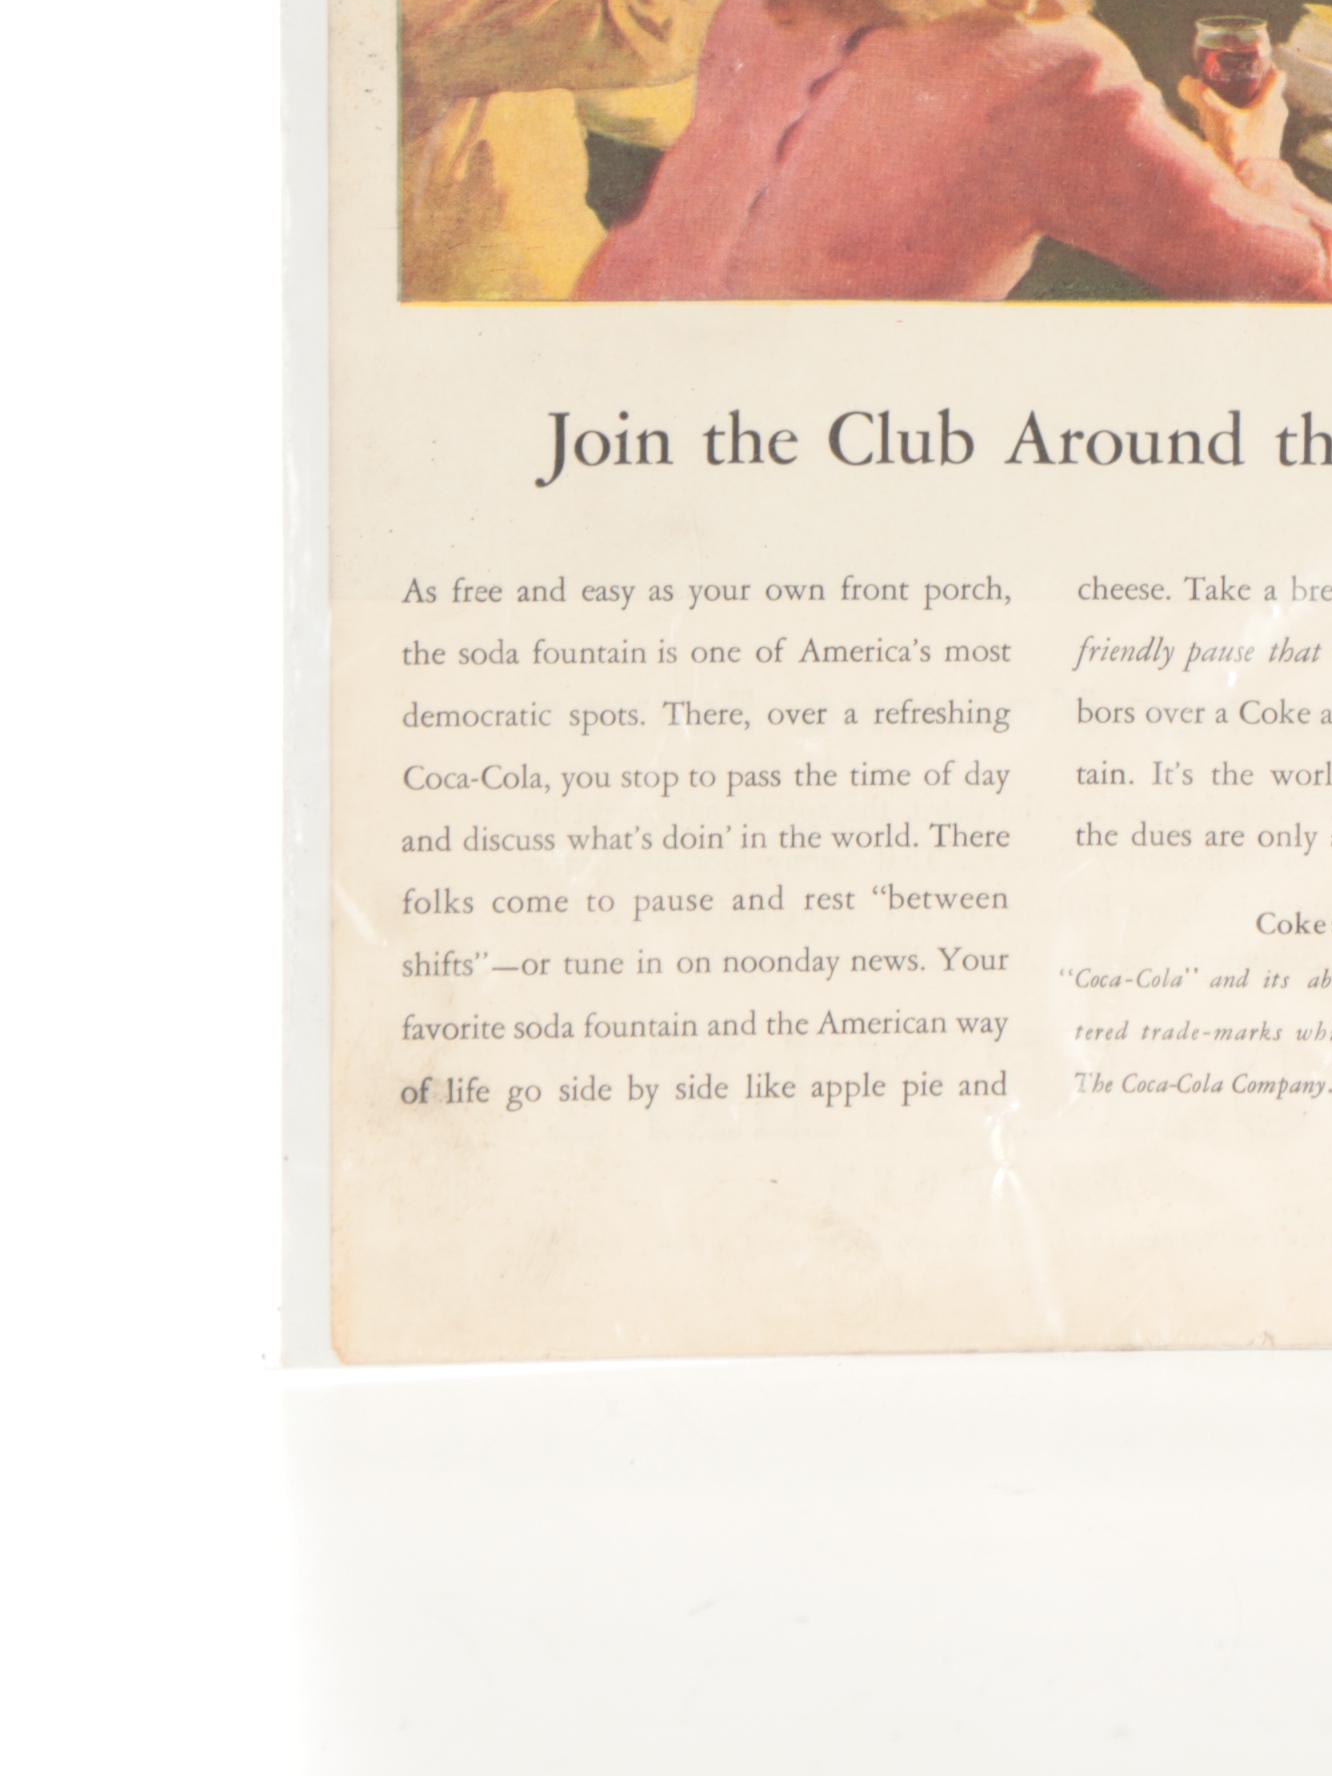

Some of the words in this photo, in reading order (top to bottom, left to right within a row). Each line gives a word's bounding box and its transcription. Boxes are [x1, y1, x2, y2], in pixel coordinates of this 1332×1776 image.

[533, 409, 674, 489] Join
[702, 408, 799, 467] the
[827, 406, 976, 467] Club
[1003, 408, 1246, 467] Around
[401, 577, 438, 604] As
[452, 576, 504, 604] free
[516, 575, 567, 603] and
[581, 584, 636, 612] easy
[648, 583, 675, 603] as
[688, 583, 752, 611] your
[764, 583, 826, 602] own
[840, 573, 910, 602] front
[923, 574, 1012, 612] porch,
[1077, 574, 1172, 601] cheese.
[1183, 574, 1252, 602] Take
[1263, 584, 1278, 602] a
[401, 639, 447, 667] the
[458, 637, 520, 666] soda
[532, 637, 647, 665] fountain
[657, 638, 678, 664] is
[690, 645, 742, 664] one
[754, 636, 788, 664] of
[798, 637, 932, 664] America's
[944, 643, 1012, 663] most
[1071, 634, 1176, 672] friendly
[1182, 641, 1255, 673] pause
[1268, 635, 1322, 664] that
[401, 700, 552, 729] democratic
[569, 707, 646, 737] spots.
[661, 699, 751, 731] There,
[766, 707, 828, 726] over
[843, 707, 859, 726] a
[873, 697, 1012, 734] refreshing
[1076, 696, 1136, 725] bors
[1144, 706, 1206, 725] over
[1214, 707, 1229, 725] a
[1238, 697, 1312, 726] Coke
[402, 762, 551, 794] Coca-Cola,
[561, 771, 611, 798] you
[620, 769, 680, 799] stop
[688, 768, 717, 788] to
[726, 769, 782, 798] pass
[793, 761, 838, 788] the
[849, 761, 912, 787] time
[923, 759, 956, 786] of
[963, 759, 1011, 796] day
[1076, 759, 1135, 786] tain.
[1152, 760, 1194, 786] It's
[1211, 760, 1254, 787] the
[401, 824, 452, 854] and
[462, 824, 556, 852] discuss
[566, 824, 653, 851] what's
[661, 823, 732, 851] doin'
[740, 823, 768, 850] in
[778, 823, 822, 849] the
[830, 820, 919, 849] world.
[928, 821, 1011, 849] There
[402, 886, 475, 916] folks
[491, 895, 569, 915] come
[586, 893, 616, 913] to
[633, 893, 714, 923] pause
[731, 883, 785, 912] and
[803, 891, 856, 911] rest
[871, 882, 1009, 911] "between
[563, 956, 625, 976] tune
[637, 948, 663, 975] in
[675, 956, 712, 974] on
[722, 945, 841, 982] noonday
[850, 953, 926, 973] news.
[937, 946, 1010, 972] Your
[1208, 966, 1251, 989] and
[1262, 969, 1291, 990] its
[401, 1013, 506, 1041] favorite
[513, 1011, 575, 1040] soda
[584, 1011, 698, 1039] fountain
[707, 1008, 757, 1037] and
[766, 1009, 810, 1037] the
[816, 1008, 947, 1036] American
[955, 1016, 1009, 1043] way
[1074, 1019, 1130, 1042] tered
[1140, 1019, 1283, 1042] trade-marks
[399, 1074, 435, 1106] of
[445, 1075, 491, 1105] life
[505, 1084, 543, 1113] go
[558, 1073, 613, 1103] side
[627, 1073, 660, 1111] by
[674, 1072, 729, 1101] side
[745, 1071, 797, 1100] like
[810, 1071, 887, 1109] apple
[901, 1070, 944, 1108] pie
[958, 1068, 1008, 1097] and
[1073, 1070, 1114, 1094] The
[1120, 1071, 1224, 1095] Coca-Cola
